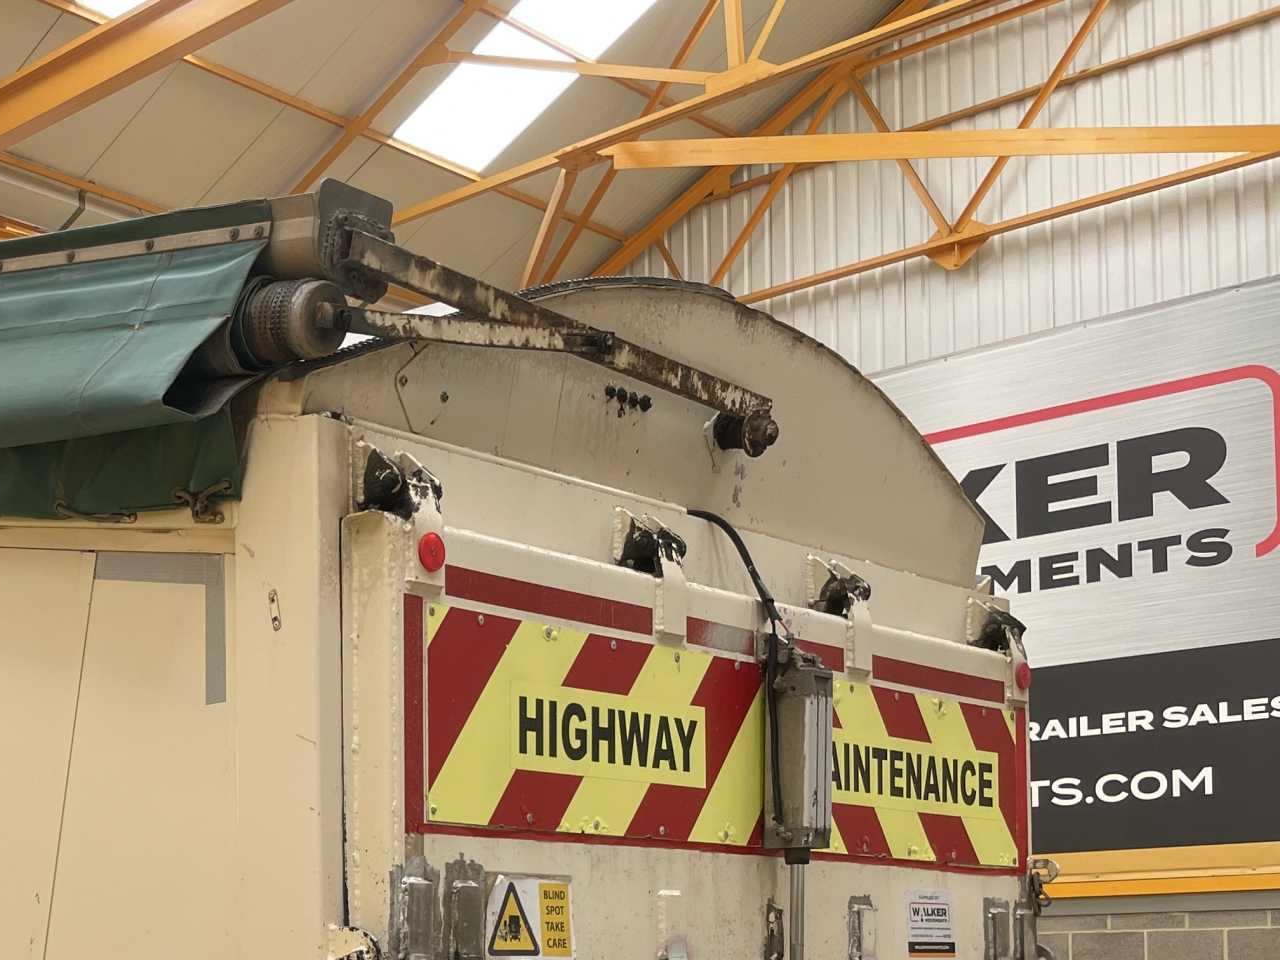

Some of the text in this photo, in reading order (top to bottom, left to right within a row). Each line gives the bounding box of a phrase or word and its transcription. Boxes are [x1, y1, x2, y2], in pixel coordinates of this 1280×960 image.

[517, 694, 699, 774] HIGHWAY
[543, 890, 566, 900] BLIND
[546, 905, 564, 915] SPOT
[912, 907, 946, 917] WALKER
[545, 921, 565, 932] TAKE
[547, 938, 567, 948] CARE
